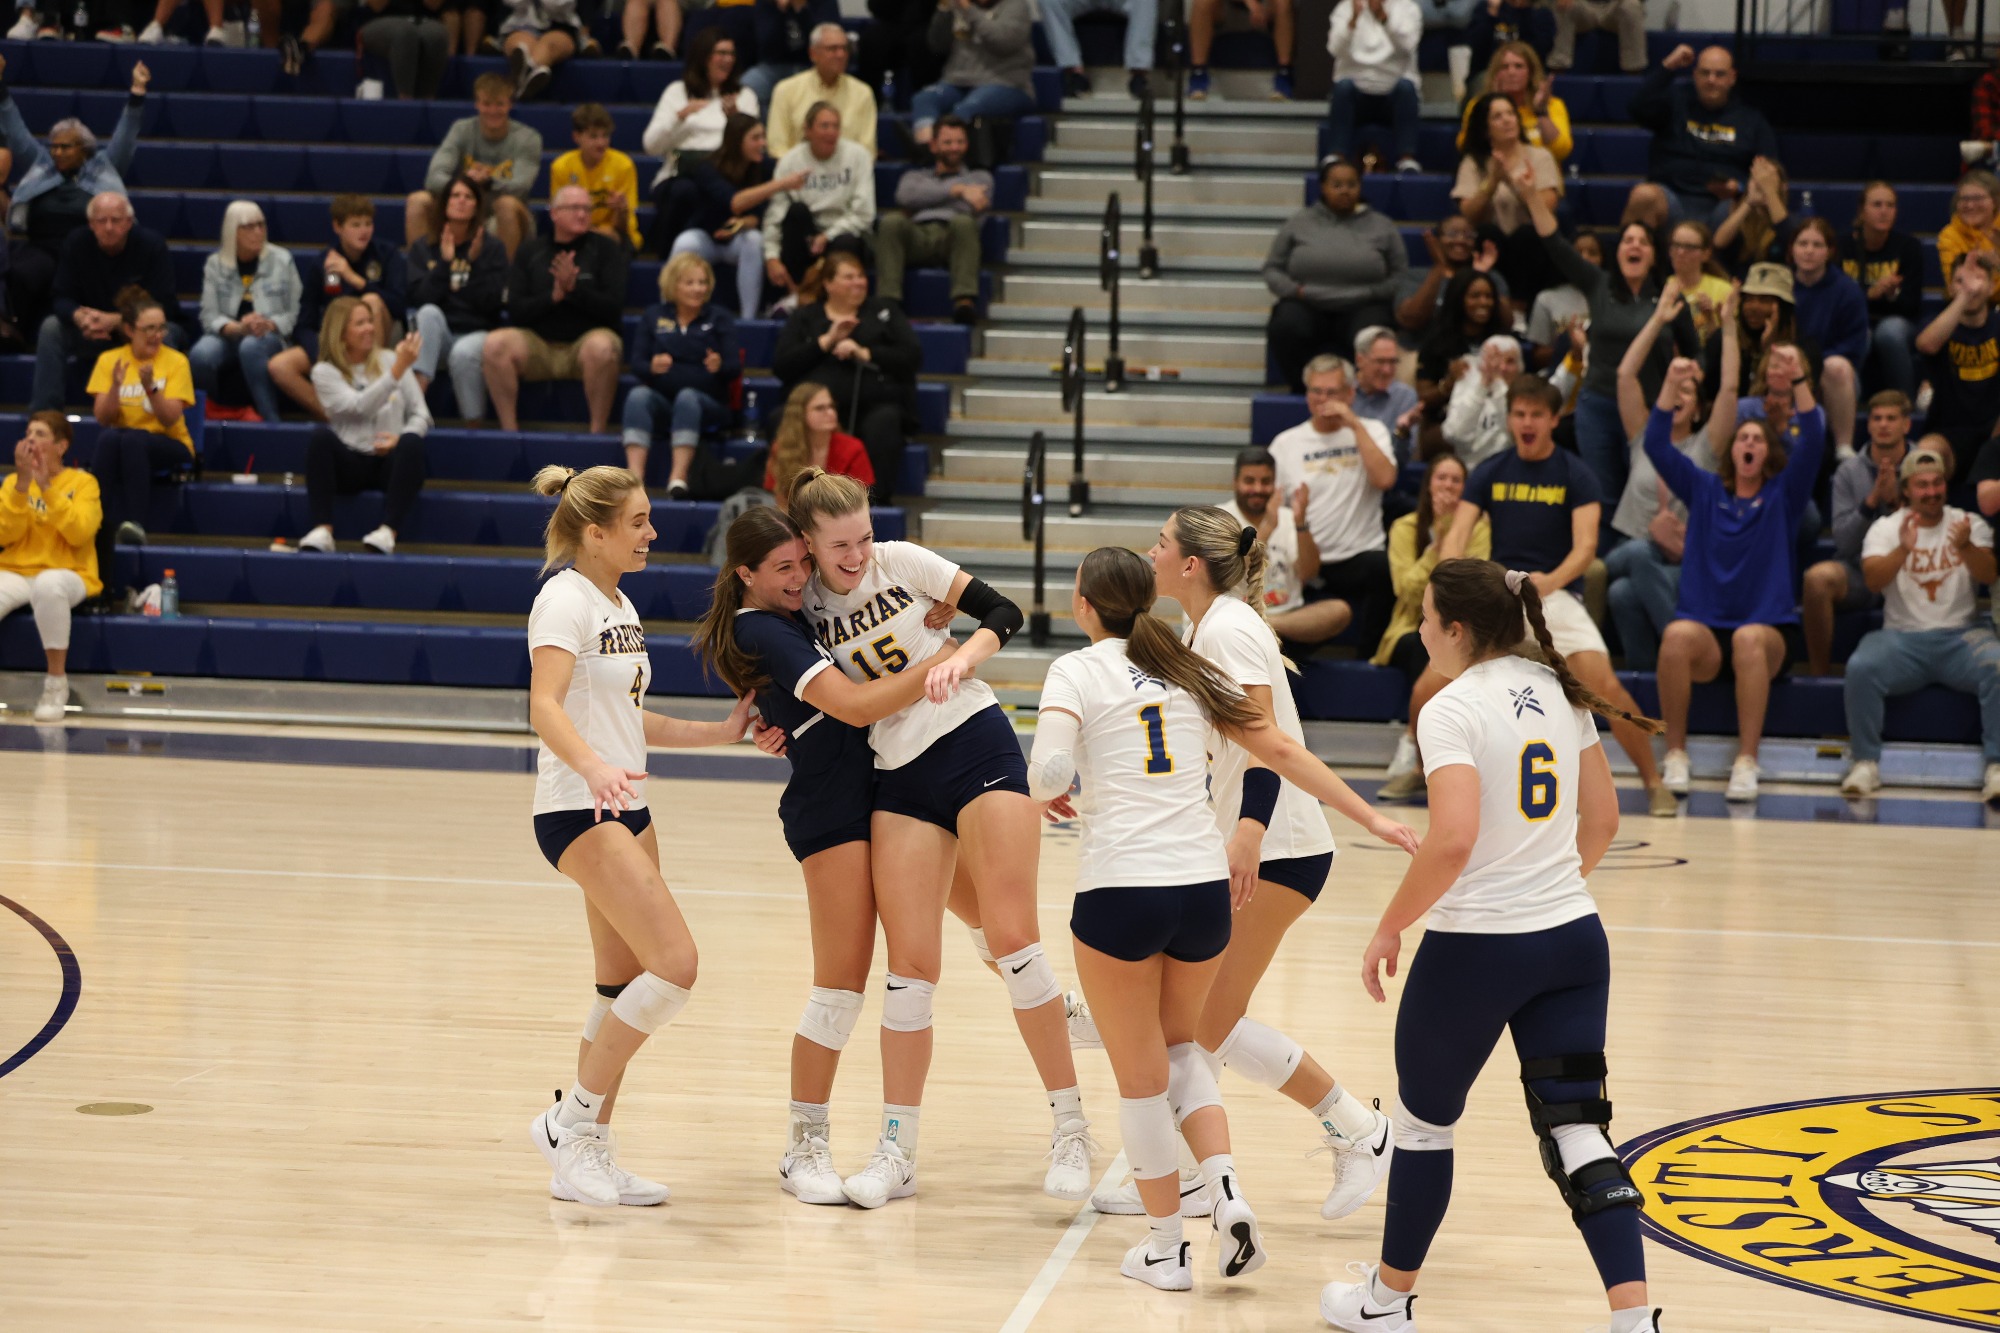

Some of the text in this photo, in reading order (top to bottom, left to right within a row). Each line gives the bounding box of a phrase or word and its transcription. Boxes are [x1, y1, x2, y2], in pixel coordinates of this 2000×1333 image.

[816, 585, 917, 649] MARIAN
[628, 663, 645, 710] 4
[850, 632, 910, 682] 15
[1137, 702, 1175, 777] 1
[1517, 738, 1560, 822] 6
